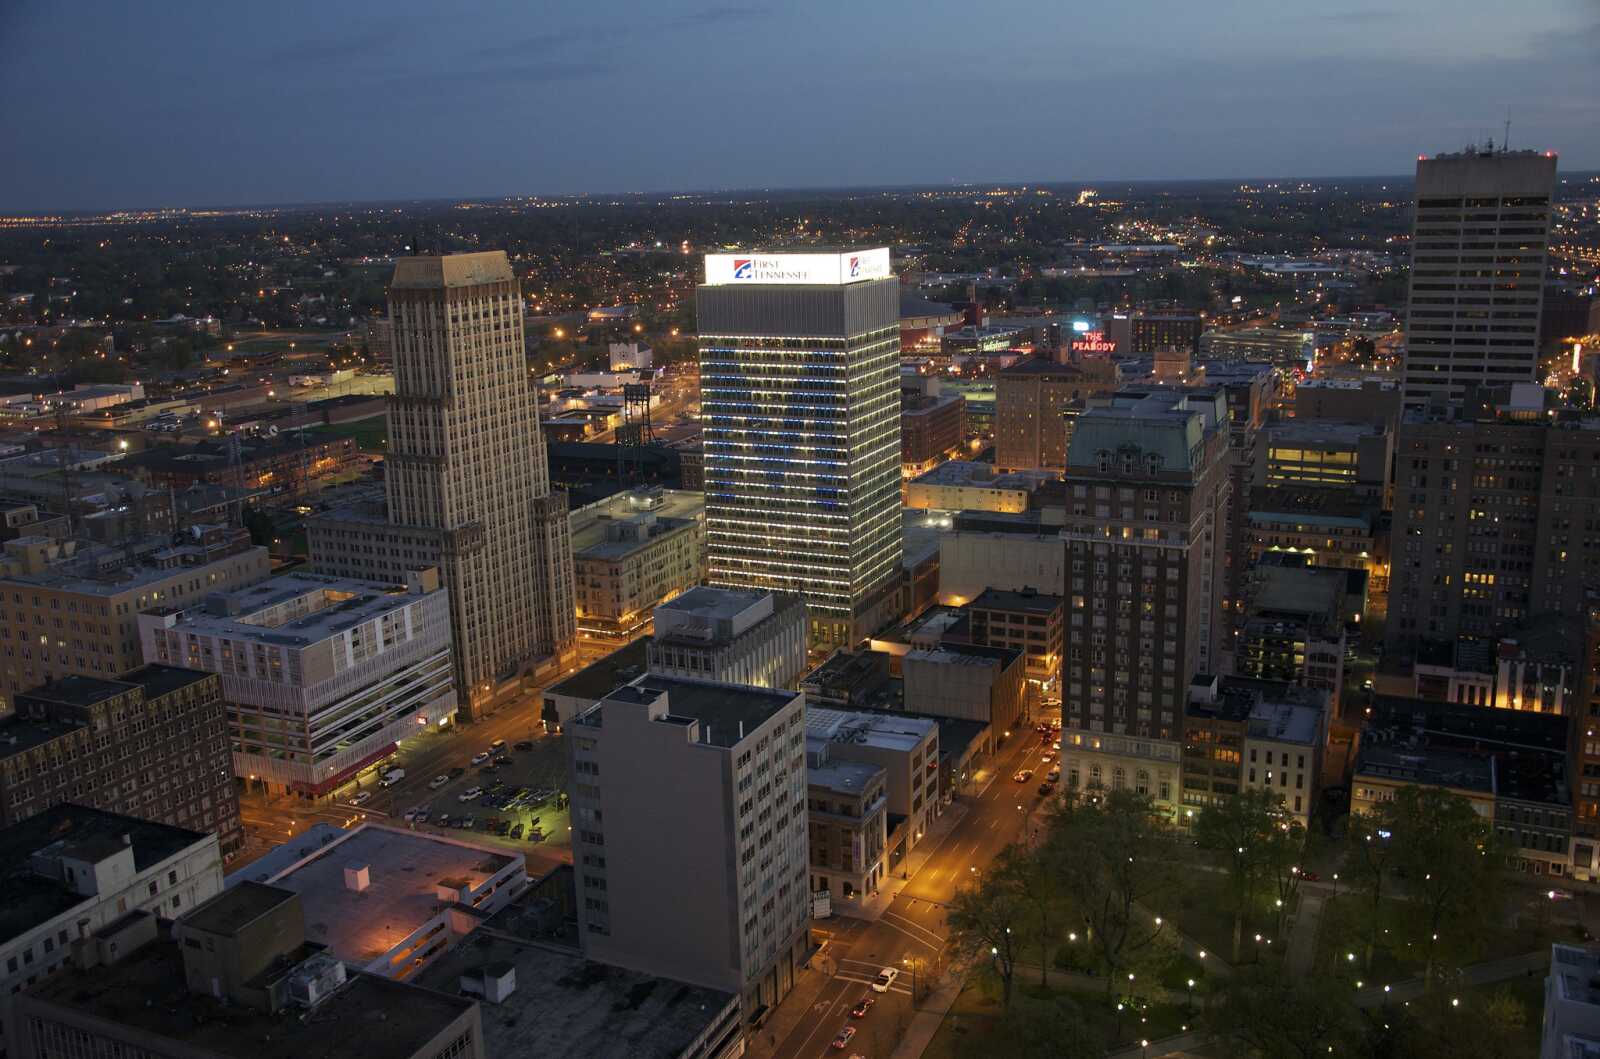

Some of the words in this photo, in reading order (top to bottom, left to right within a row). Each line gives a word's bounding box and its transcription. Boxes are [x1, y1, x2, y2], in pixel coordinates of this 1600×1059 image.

[753, 259, 781, 269] FIRST
[753, 270, 808, 280] TENNESSEE
[1085, 332, 1103, 341] THE
[1072, 342, 1116, 352] PEABODY
